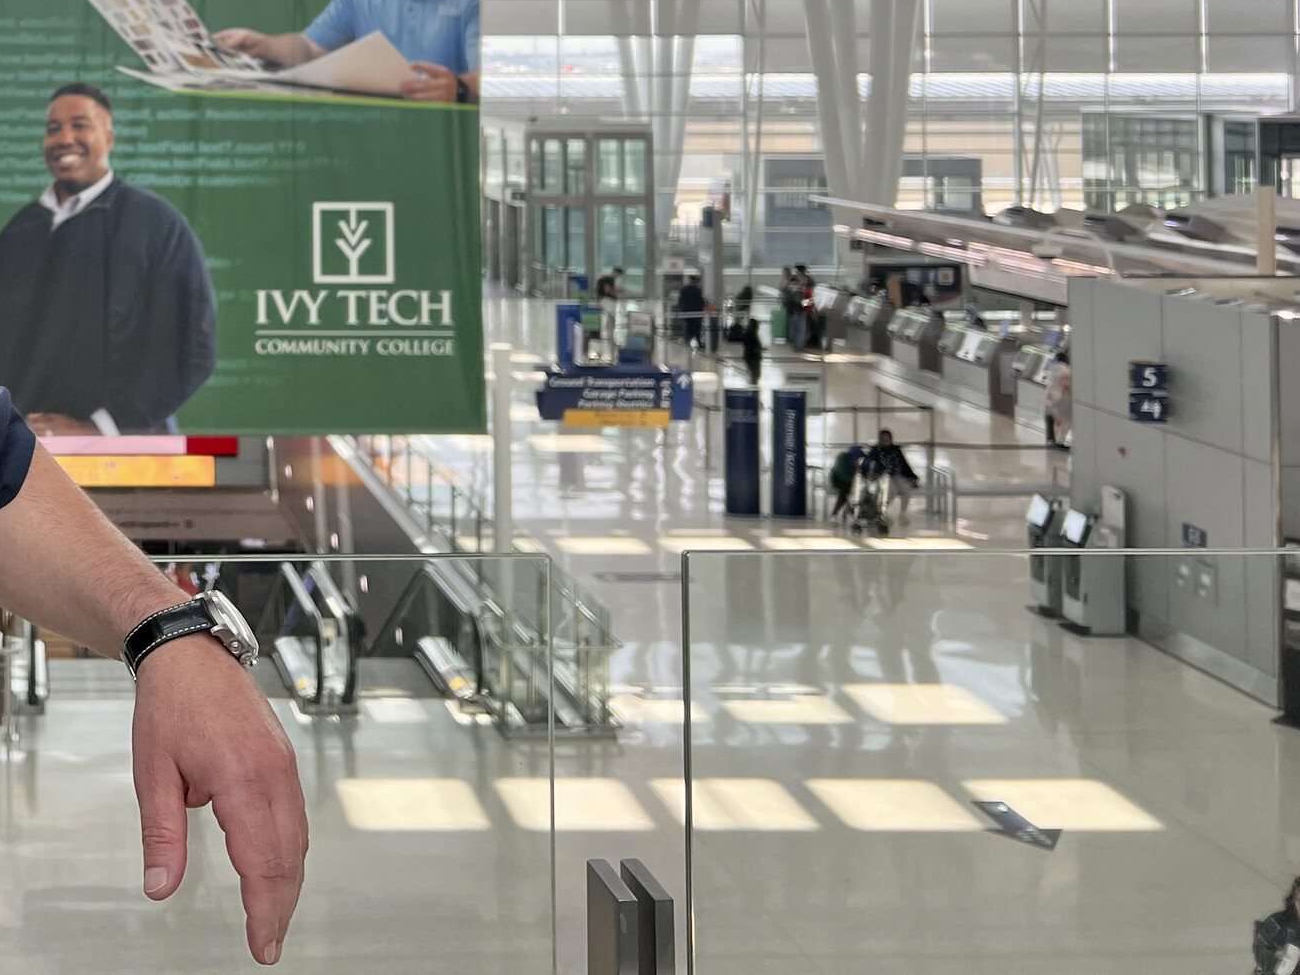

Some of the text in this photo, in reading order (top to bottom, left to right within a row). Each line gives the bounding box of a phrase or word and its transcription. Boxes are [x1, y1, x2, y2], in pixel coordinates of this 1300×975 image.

[255, 290, 453, 325] IVY TECH
[255, 339, 455, 356] COMMUNITY COLLEGE
[549, 376, 655, 388] Ground Transportation
[1142, 367, 1157, 387] 5
